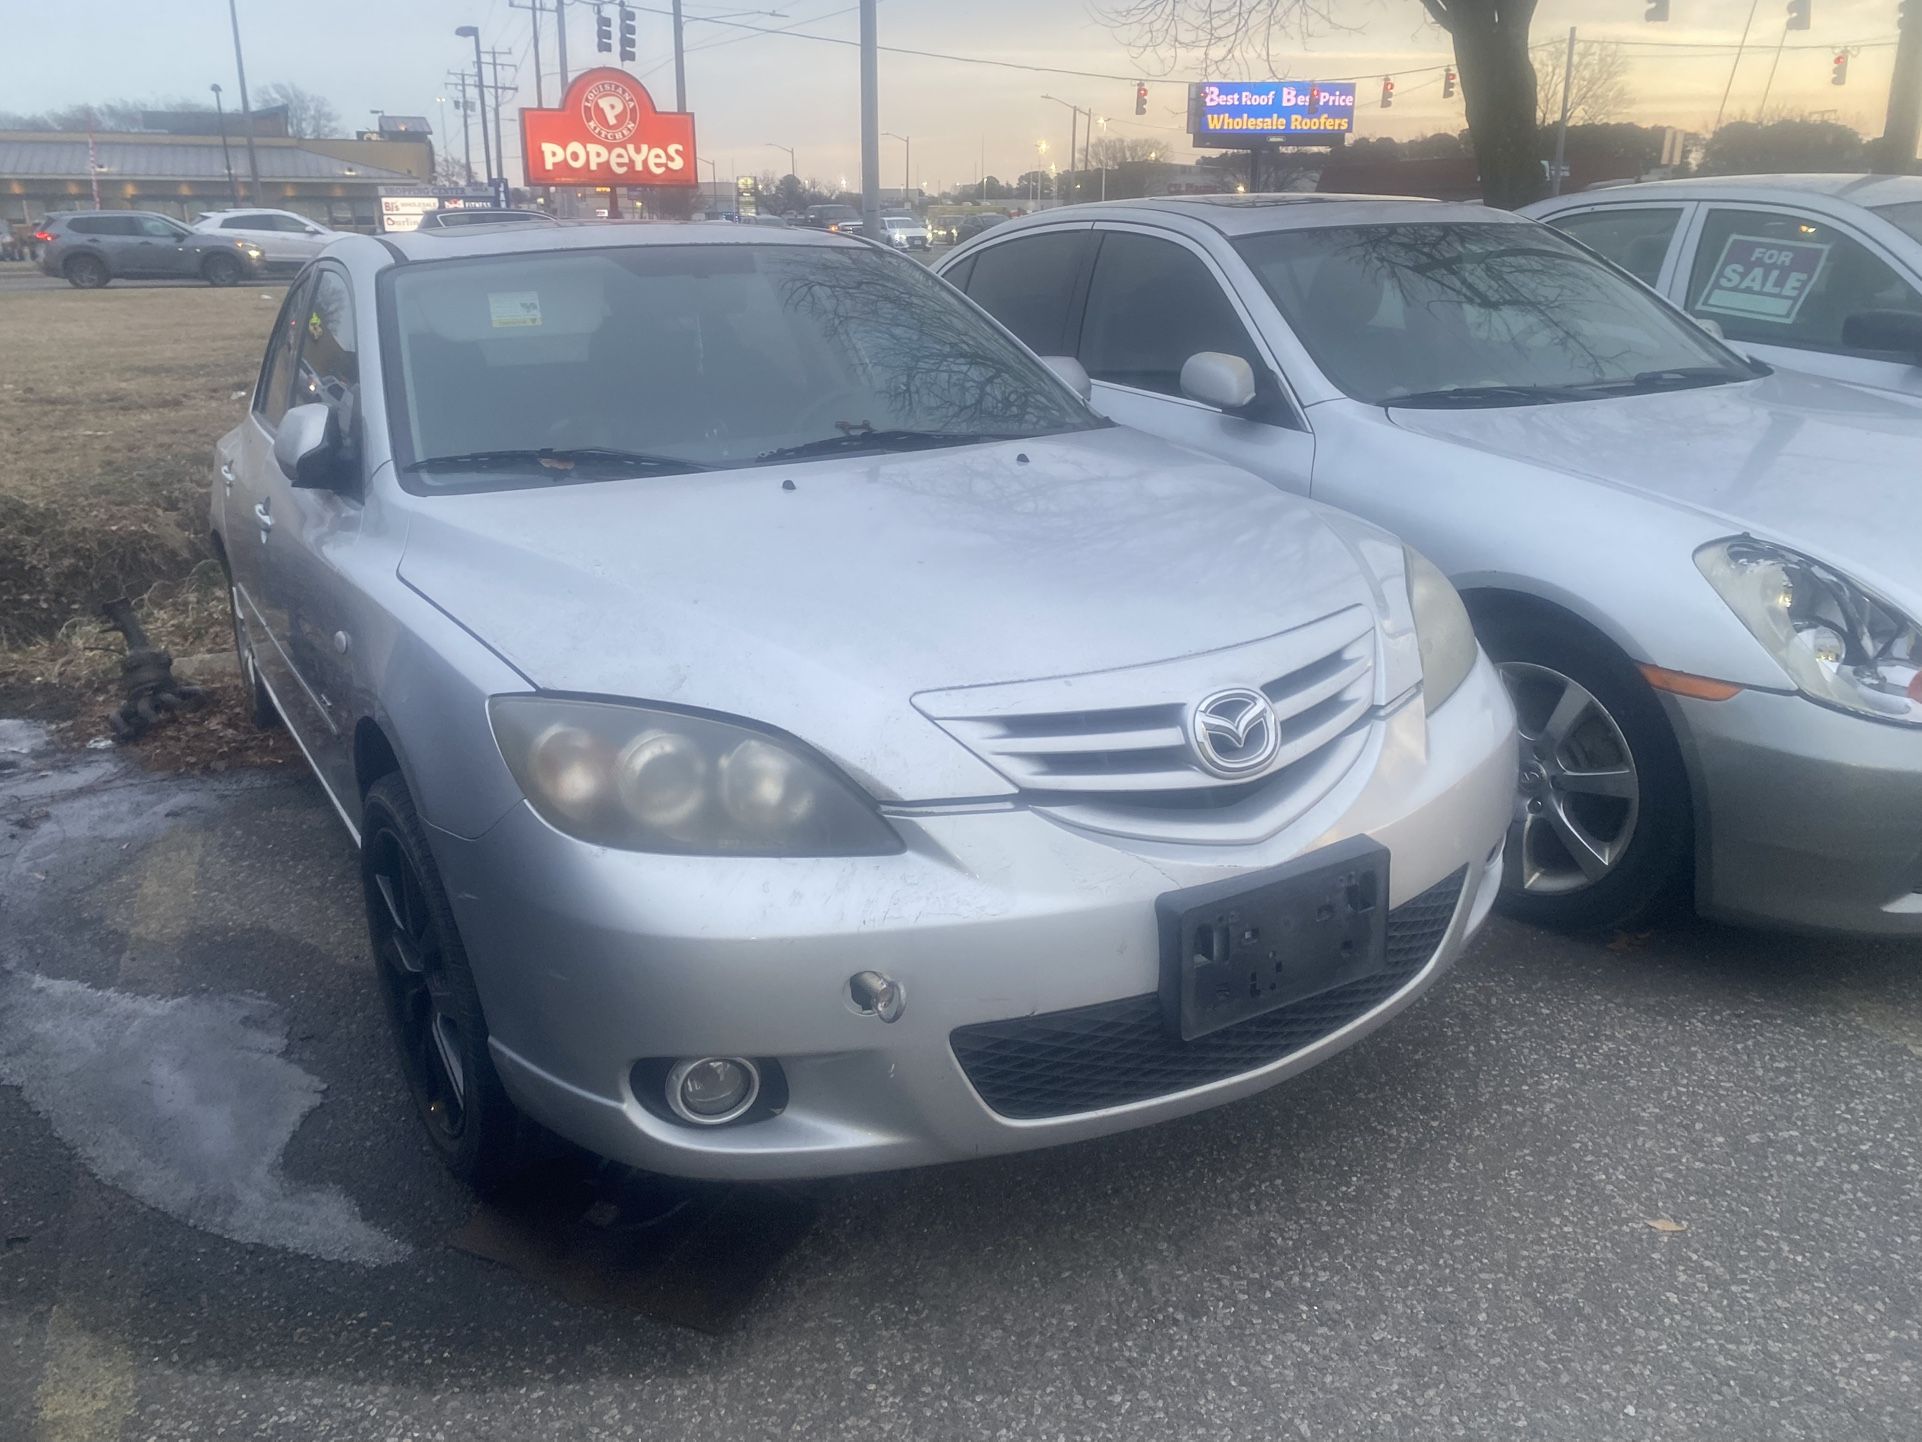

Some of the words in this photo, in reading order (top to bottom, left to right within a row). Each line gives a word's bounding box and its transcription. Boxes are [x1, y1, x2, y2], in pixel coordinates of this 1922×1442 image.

[584, 84, 635, 108] LOUISIANA
[1205, 86, 1239, 107] Best
[1242, 91, 1275, 106] Roof
[1282, 87, 1311, 107] Bes
[1319, 91, 1354, 106] Price
[597, 96, 624, 126] P
[588, 120, 635, 141] KITCHEN
[1207, 114, 1286, 130] Wholesale
[1290, 114, 1349, 130] Roofers
[1751, 248, 1794, 266] FOR
[1719, 263, 1808, 297] SALE
